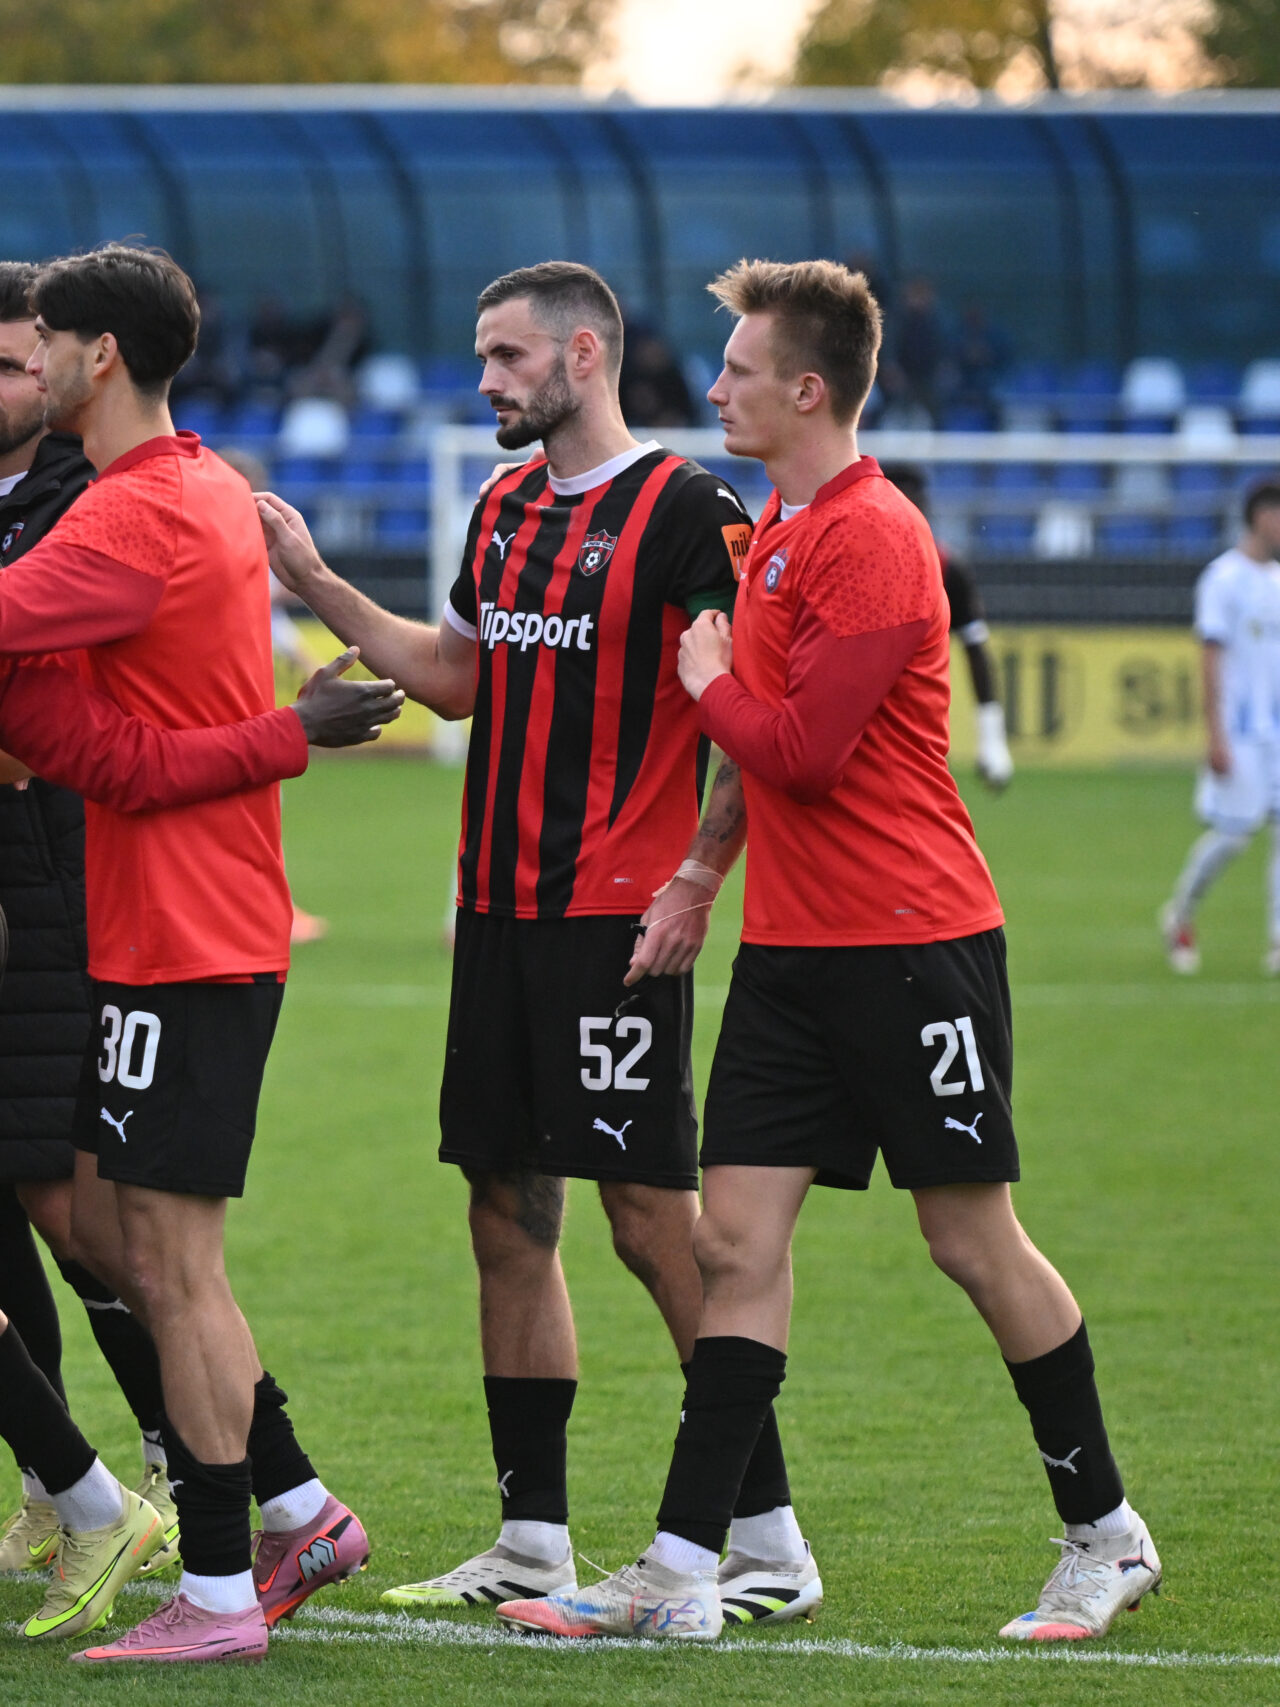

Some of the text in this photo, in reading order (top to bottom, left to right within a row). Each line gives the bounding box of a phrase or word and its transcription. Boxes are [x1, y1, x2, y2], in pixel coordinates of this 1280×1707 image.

[480, 602, 595, 652] Tipsport
[97, 1004, 162, 1091] 30
[579, 1016, 653, 1091] 52
[920, 1015, 986, 1097] 21
